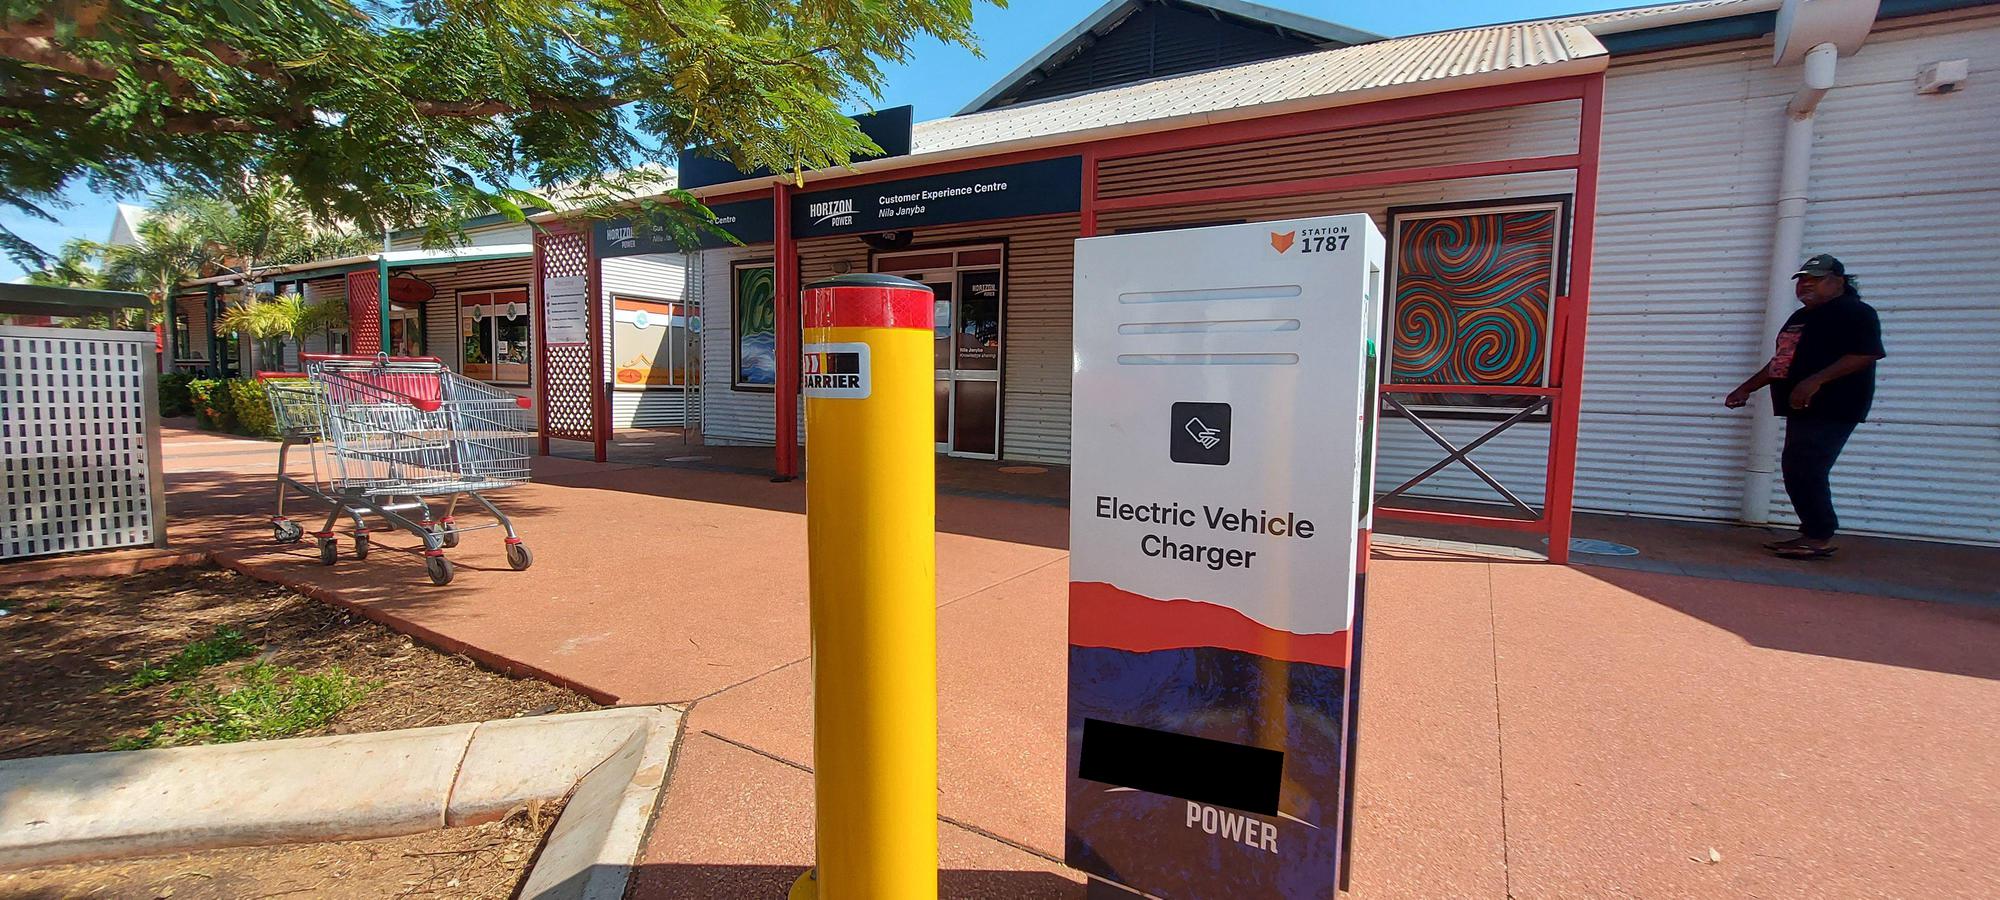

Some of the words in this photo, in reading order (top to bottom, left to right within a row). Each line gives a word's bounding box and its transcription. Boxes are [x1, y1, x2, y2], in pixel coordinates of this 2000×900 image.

[879, 192, 920, 205] Customer
[921, 187, 972, 201] Experience
[974, 181, 1008, 194] Centre
[810, 199, 853, 218] HORIZON
[878, 207, 894, 218] Nila
[895, 204, 926, 217] Janyba
[831, 215, 853, 227] POWER
[1301, 226, 1348, 237] STATION
[1301, 235, 1350, 254] 1787
[1095, 495, 1197, 528] Electric
[1202, 505, 1315, 539] Vehicle
[1140, 534, 1257, 571] Charger
[1186, 800, 1279, 854] POWER
